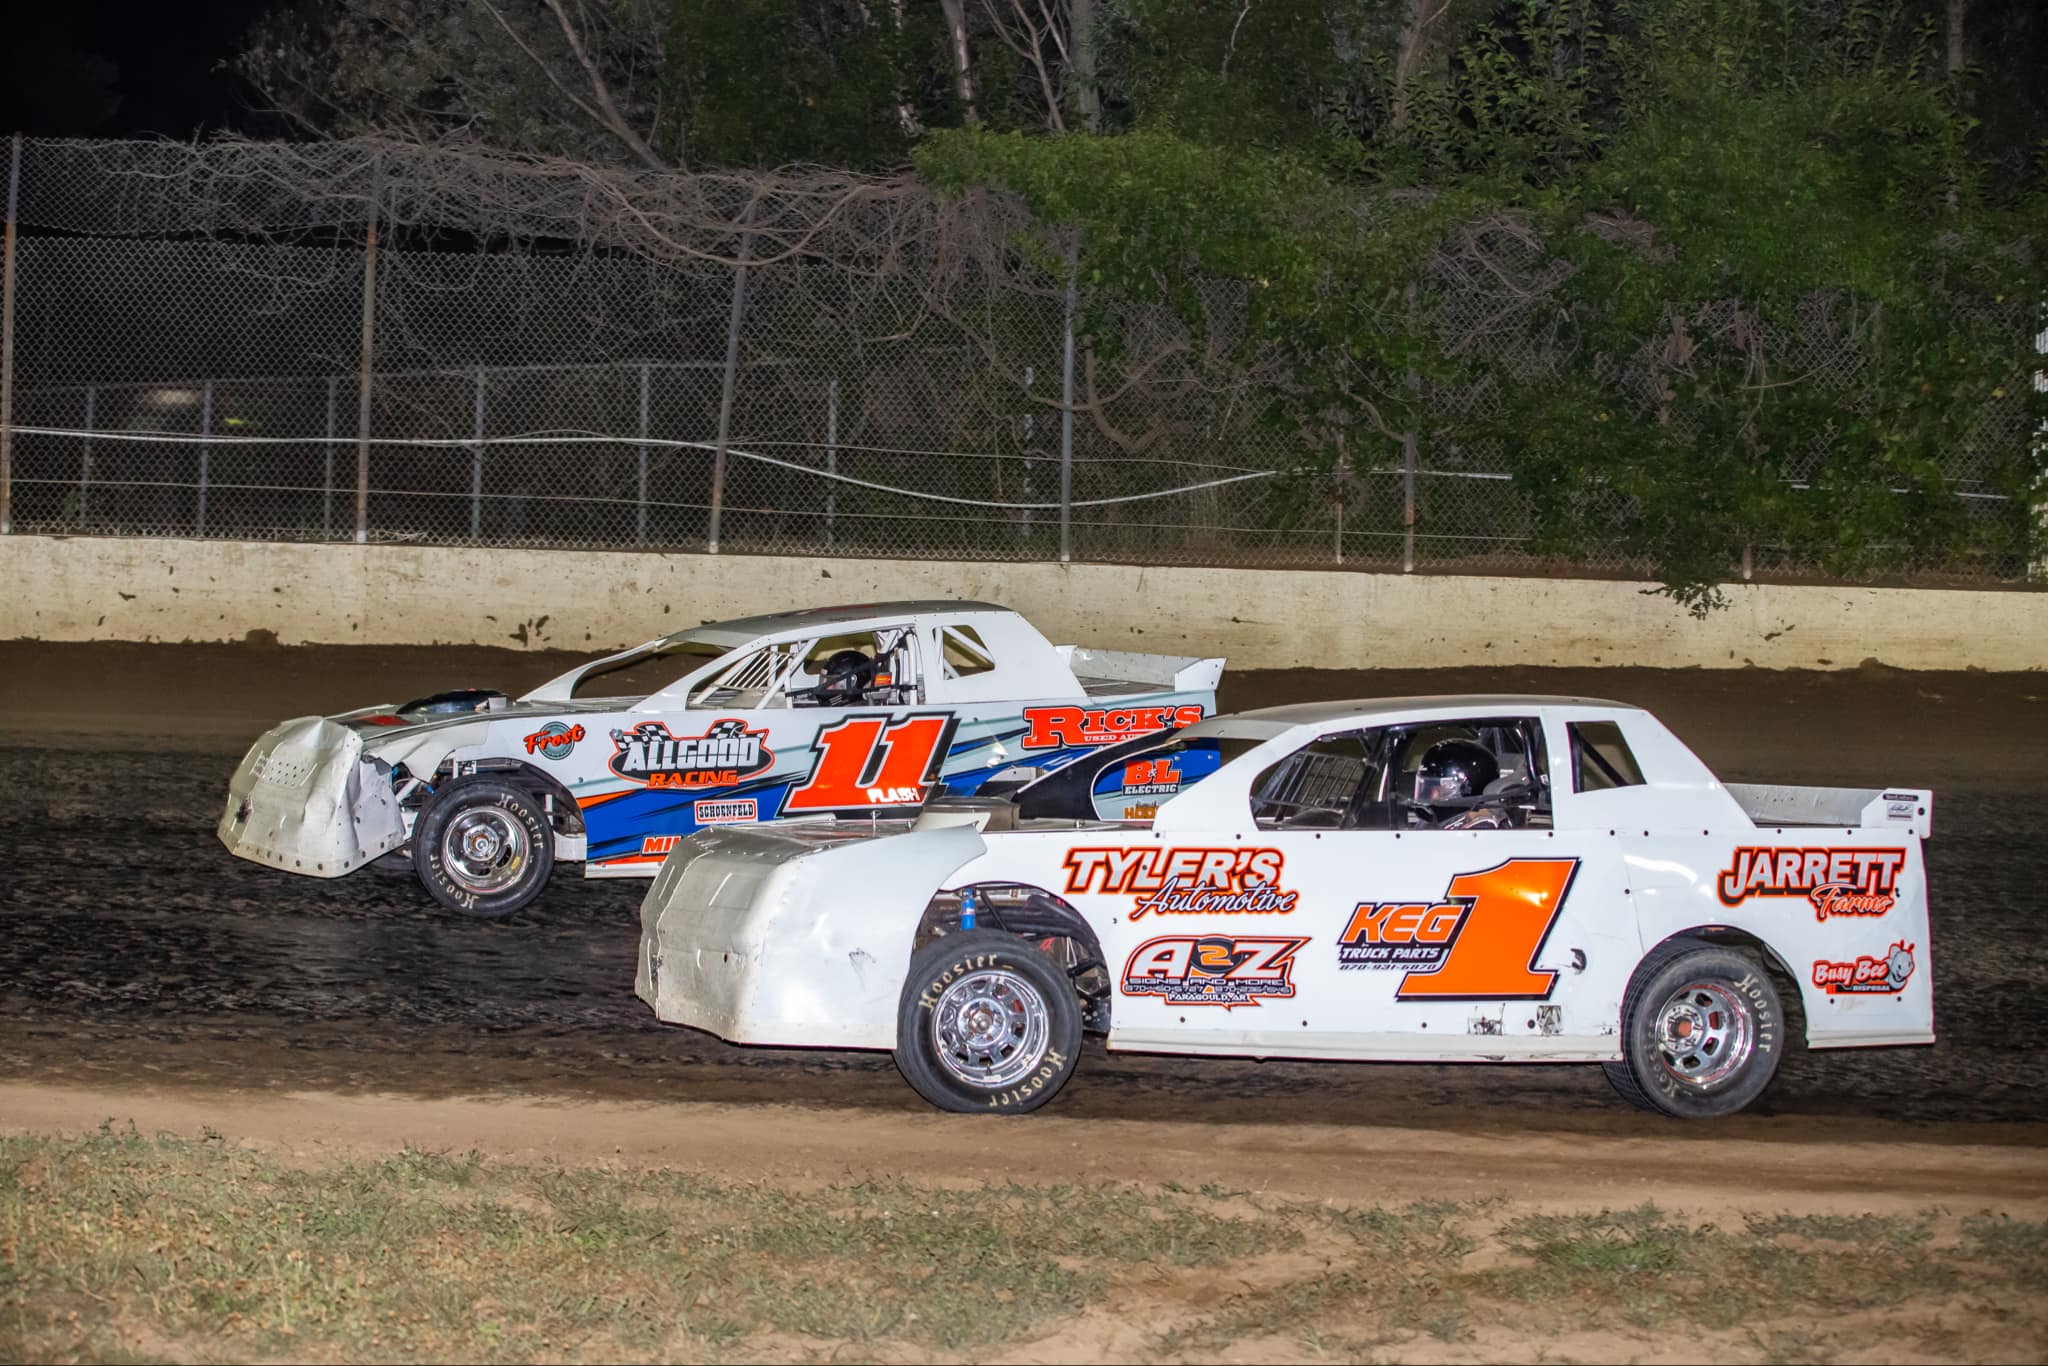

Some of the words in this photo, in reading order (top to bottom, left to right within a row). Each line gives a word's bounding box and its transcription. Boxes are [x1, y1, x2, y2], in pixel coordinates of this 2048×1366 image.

[523, 724, 585, 754] Frost
[1023, 706, 1202, 748] RICK'S
[622, 737, 761, 772] ALLGOOD
[783, 713, 952, 812] 11
[1124, 759, 1181, 785] B&L
[649, 770, 739, 787] RACING
[867, 787, 921, 803] FLASH
[1124, 784, 1178, 795] ELECTRIC
[495, 793, 545, 849] Hoosier
[698, 803, 754, 818] SCHOENFELD
[429, 854, 481, 910] Hoosier
[1067, 849, 1283, 891] TYLER'S
[1724, 851, 1903, 898] JARRETT
[1132, 875, 1298, 919] Automotive
[1810, 882, 1893, 918] Farms
[1340, 904, 1467, 943] KEG
[1397, 858, 1579, 998] 1
[1128, 938, 1298, 979] A2Z
[1341, 947, 1392, 959] TRUCK
[1392, 947, 1441, 959] PARTS
[918, 953, 998, 1014] Hoosier
[1128, 977, 1182, 985] SIGNS
[1188, 977, 1227, 985] AND
[1235, 978, 1285, 986] MORE
[1815, 964, 1854, 987] Busy
[1855, 960, 1889, 981] Bee
[1231, 993, 1247, 1001] AR
[1733, 974, 1776, 1053] Hoosier
[989, 1047, 1068, 1108] Hoosier
